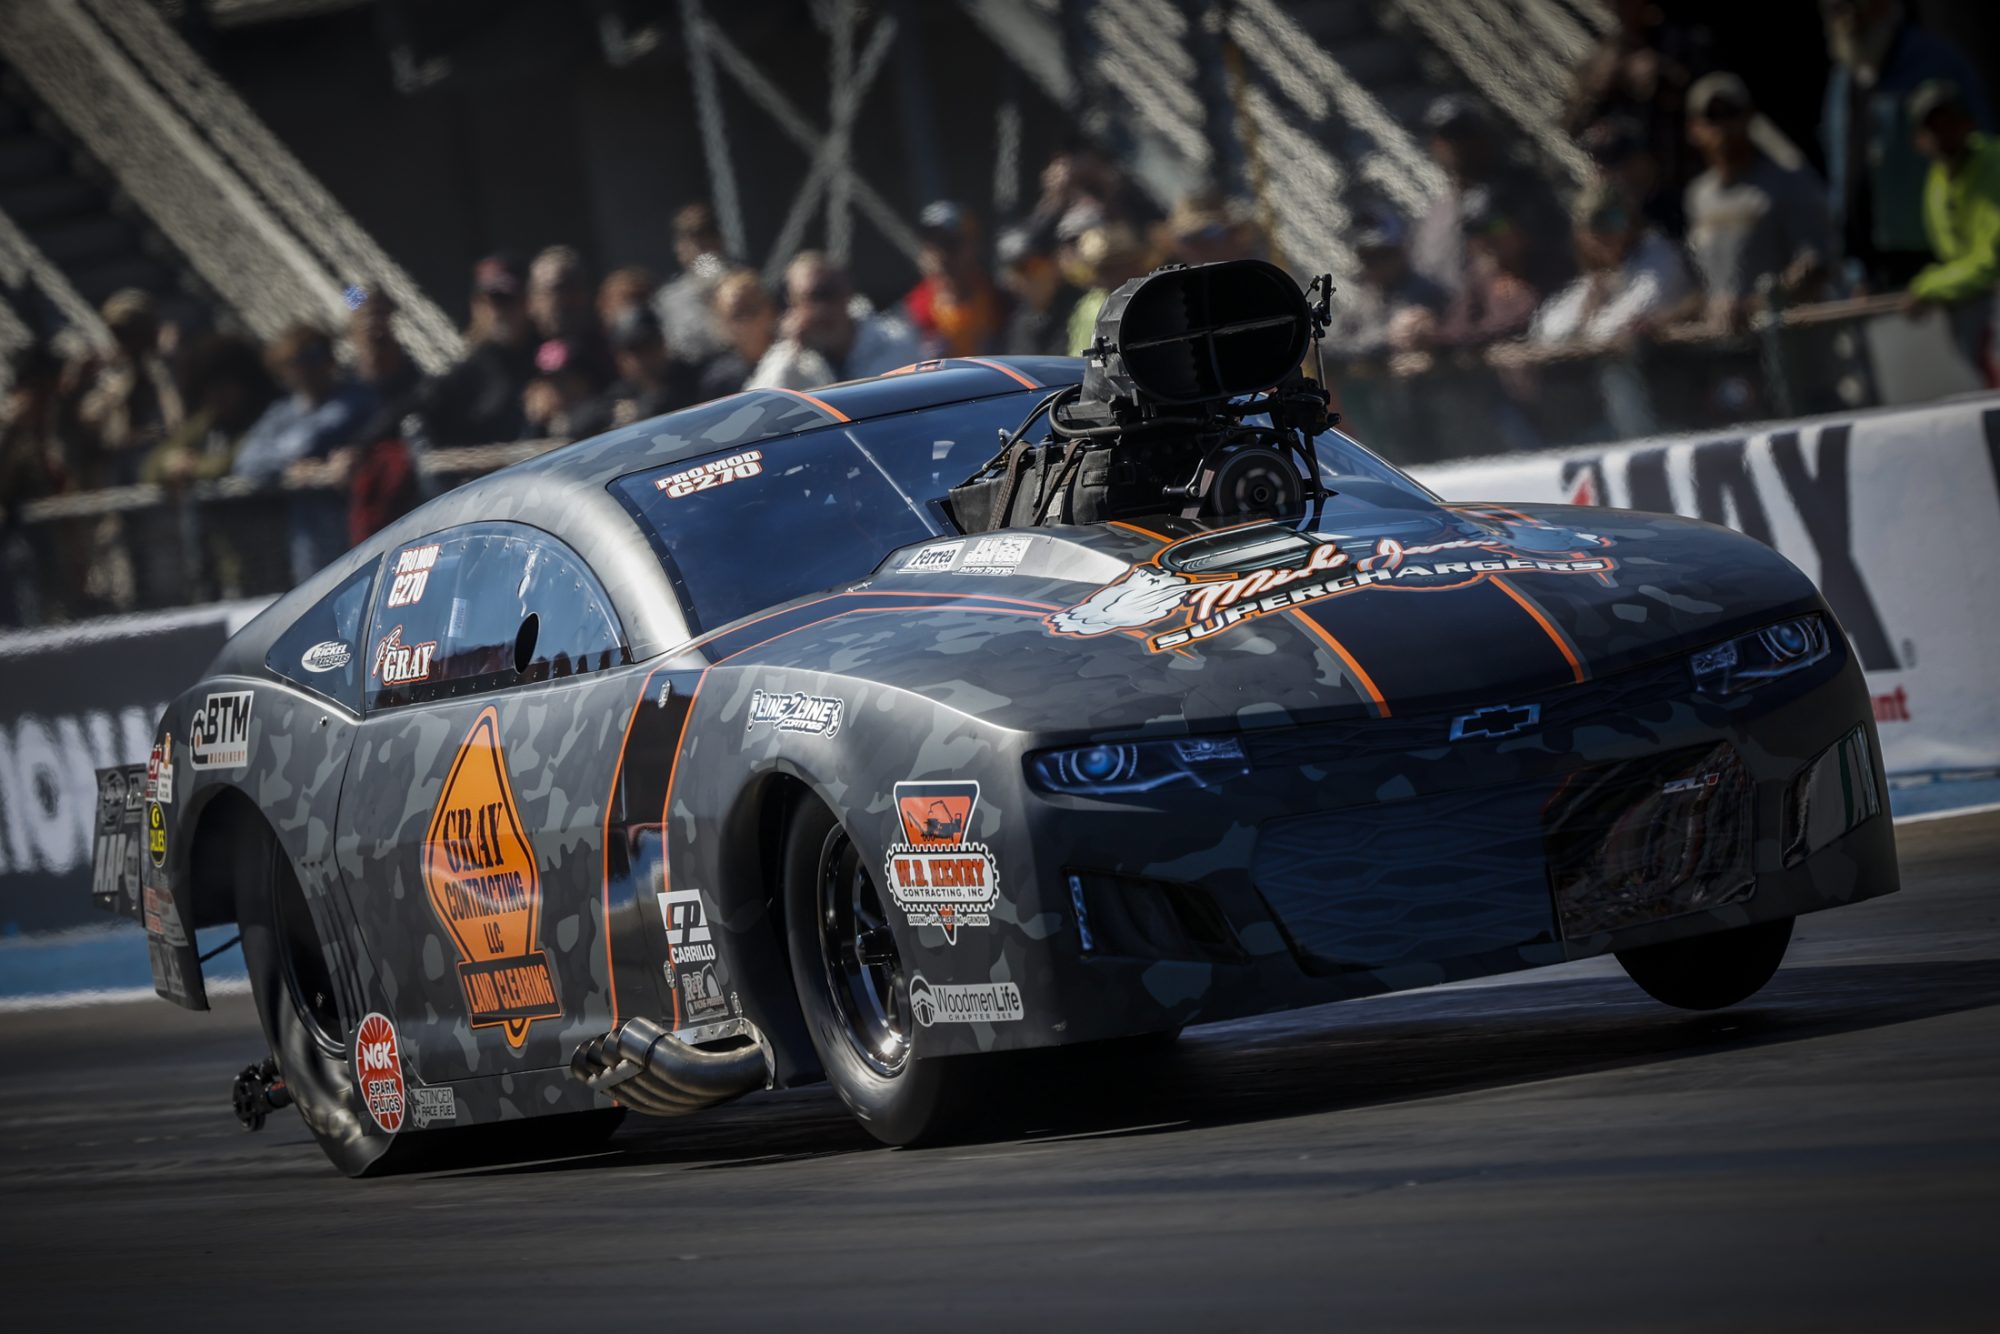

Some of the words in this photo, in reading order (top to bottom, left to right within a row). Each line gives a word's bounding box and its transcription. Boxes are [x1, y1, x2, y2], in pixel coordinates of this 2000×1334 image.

[656, 467, 704, 490] PRO
[704, 450, 762, 473] MOD
[667, 461, 762, 498] C270
[396, 549, 419, 574] PRO
[414, 545, 440, 571] MOD
[911, 548, 956, 566] Ferrea
[388, 570, 429, 607] C270
[1156, 559, 1604, 649] SUPERCHARGERS
[383, 644, 435, 682] GRAY
[207, 695, 251, 744] BTM
[442, 802, 504, 874] GRAY
[928, 858, 985, 887] HENRY
[444, 870, 528, 921] CONTRACTING
[902, 888, 966, 898] CONTRACTING,
[968, 887, 984, 897] INC
[483, 922, 505, 954] LLC
[671, 943, 716, 964] CARRILLO
[463, 971, 500, 1014] LAND
[494, 964, 555, 1010] CLEARING
[933, 985, 1020, 1013] WoodmenLife
[948, 1012, 991, 1021] CHAPTER
[362, 1041, 393, 1072] NGK
[369, 1079, 396, 1096] SPARK
[420, 1088, 453, 1105] STINGER
[373, 1097, 400, 1113] PLUGS
[421, 1105, 438, 1118] RACE
[439, 1104, 456, 1117] FUEL
